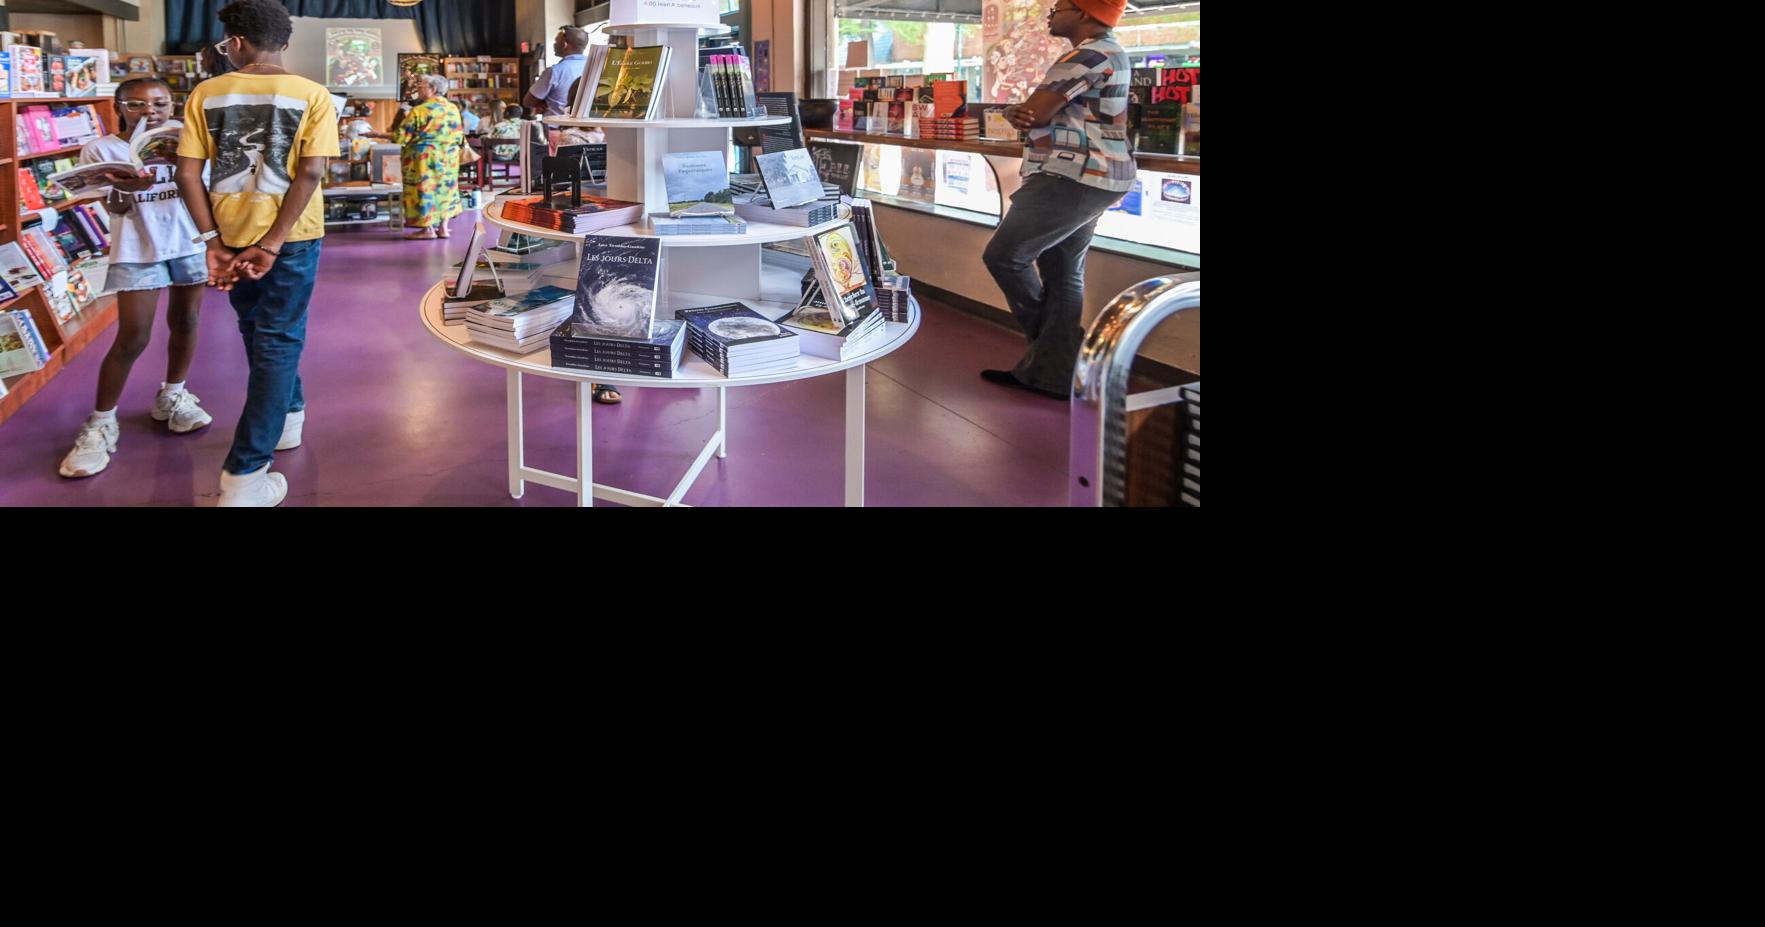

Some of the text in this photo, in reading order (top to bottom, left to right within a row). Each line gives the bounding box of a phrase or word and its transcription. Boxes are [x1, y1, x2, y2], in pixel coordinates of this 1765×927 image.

[1161, 68, 1200, 86] HOT
[1151, 85, 1191, 104] HOT
[627, 255, 653, 265] DELTA
